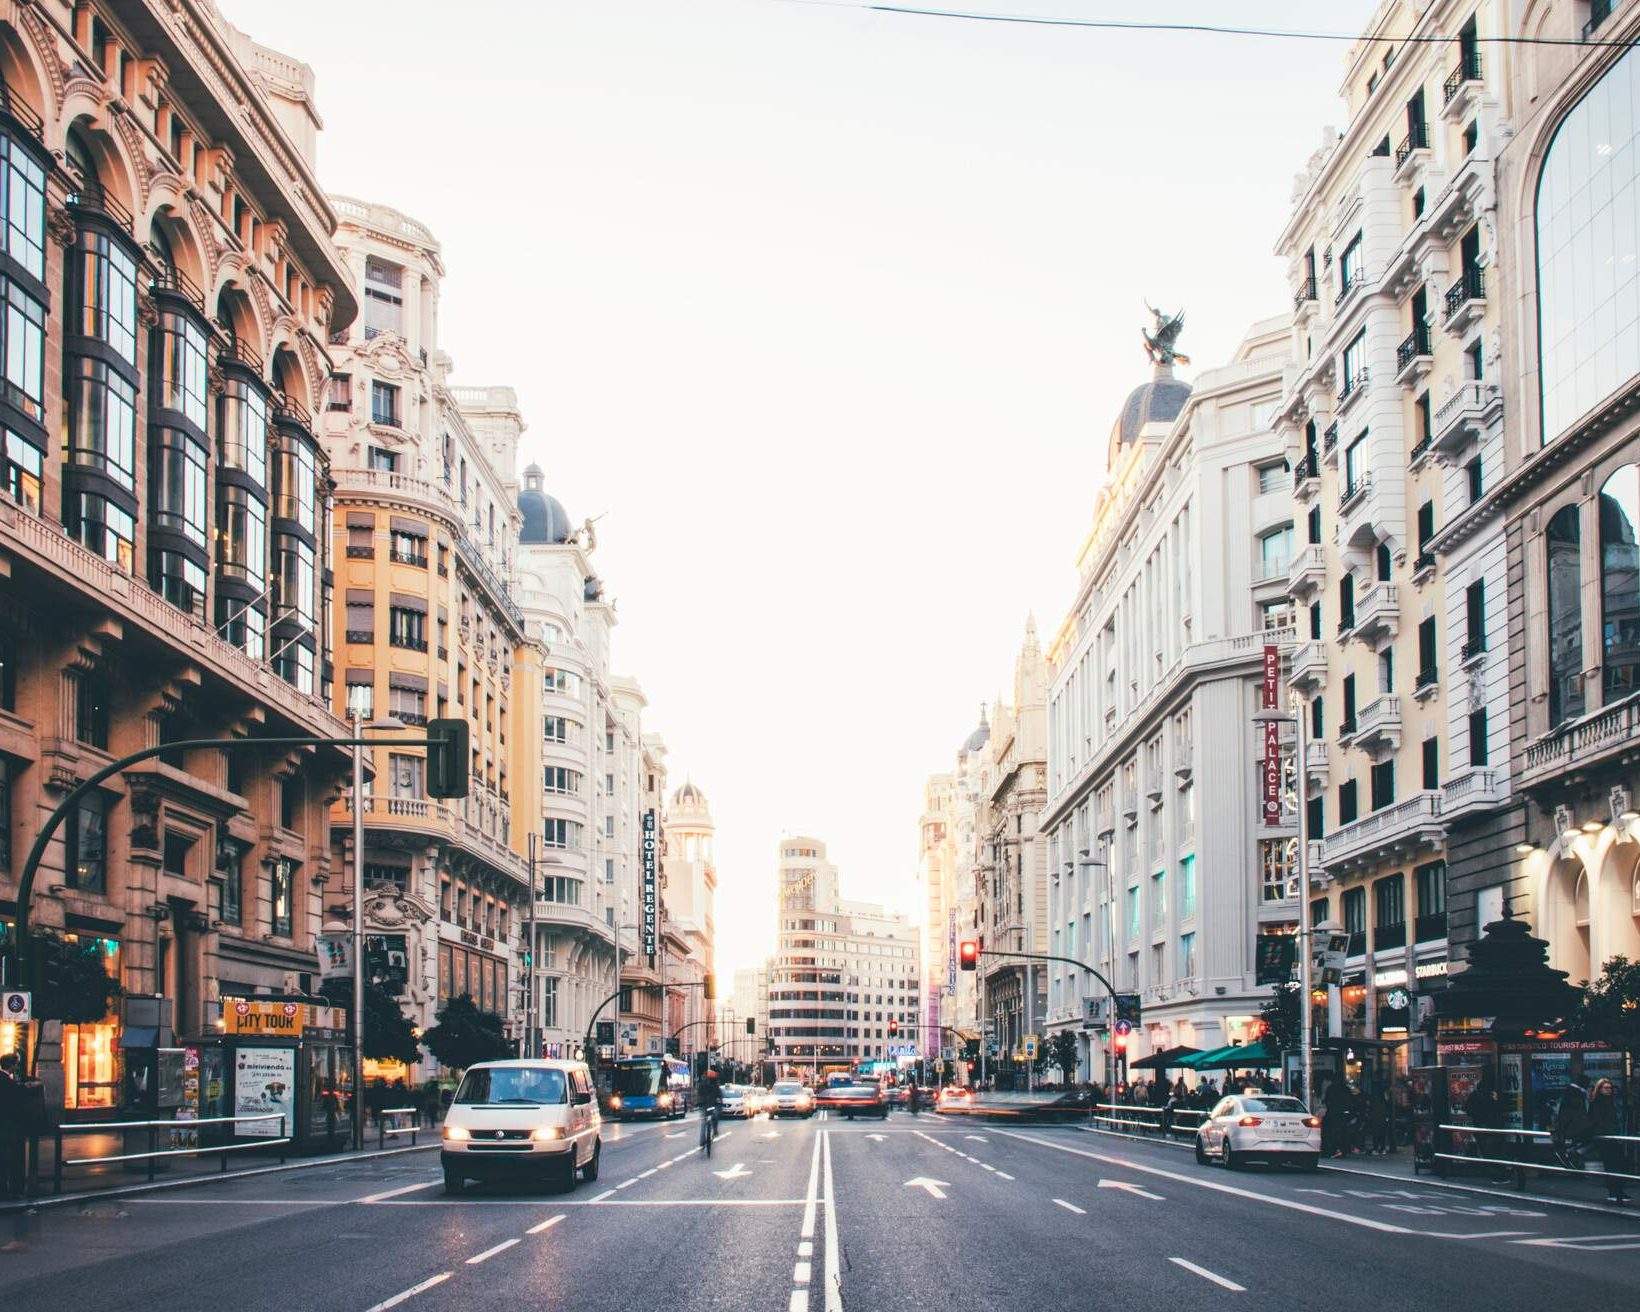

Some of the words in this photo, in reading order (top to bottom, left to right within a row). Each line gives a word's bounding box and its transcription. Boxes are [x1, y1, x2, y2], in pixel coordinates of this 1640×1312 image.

[1268, 722, 1277, 796] PALACE
[644, 830, 655, 879] HOTEL
[645, 884, 655, 954] REGENTE
[1415, 962, 1448, 979] STARBUCK
[237, 1013, 261, 1028] CITY
[264, 1014, 294, 1029] TOUR
[1550, 1041, 1580, 1049] TOURIST
[1294, 1188, 1471, 1199] TAXI
[1377, 1203, 1548, 1217] BUS
